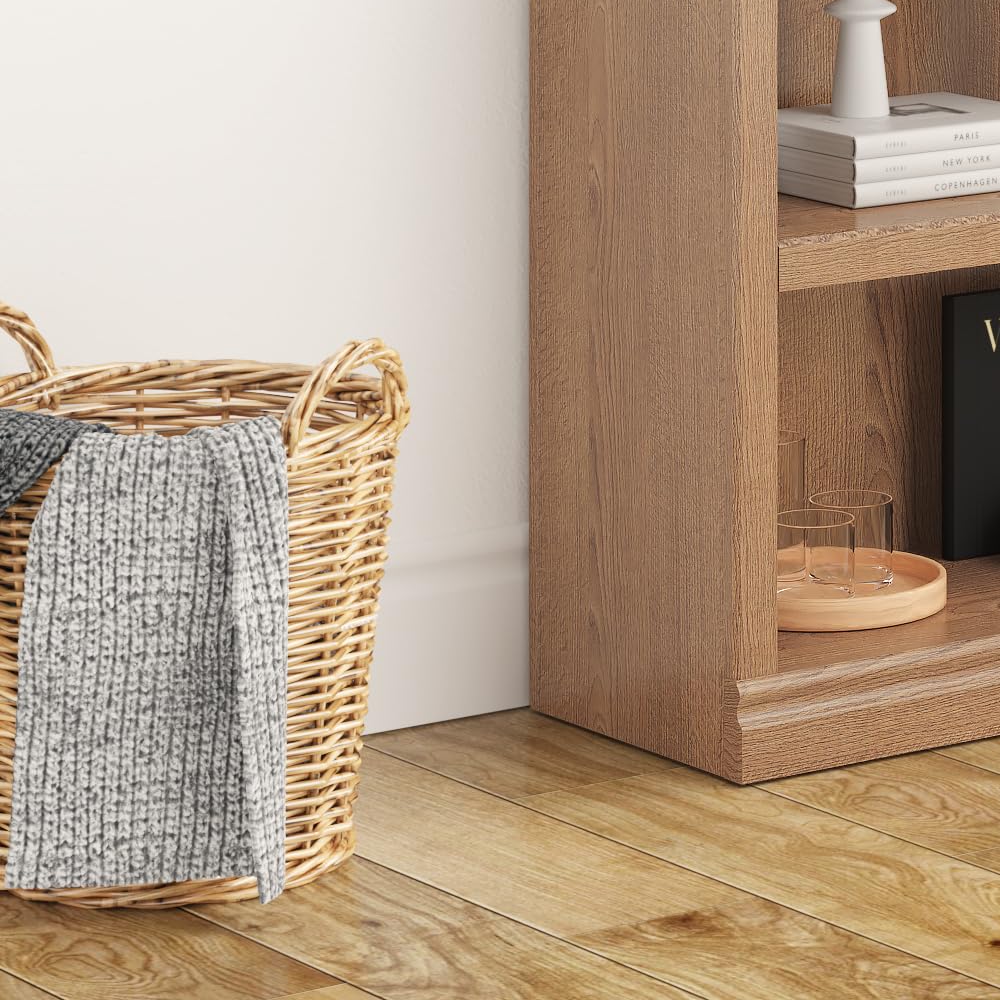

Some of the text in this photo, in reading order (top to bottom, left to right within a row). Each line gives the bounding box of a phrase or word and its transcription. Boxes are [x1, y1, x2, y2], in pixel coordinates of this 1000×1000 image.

[953, 131, 981, 142] PARIS
[942, 154, 991, 168] NEW YORK
[934, 177, 998, 192] COPENHAGEN
